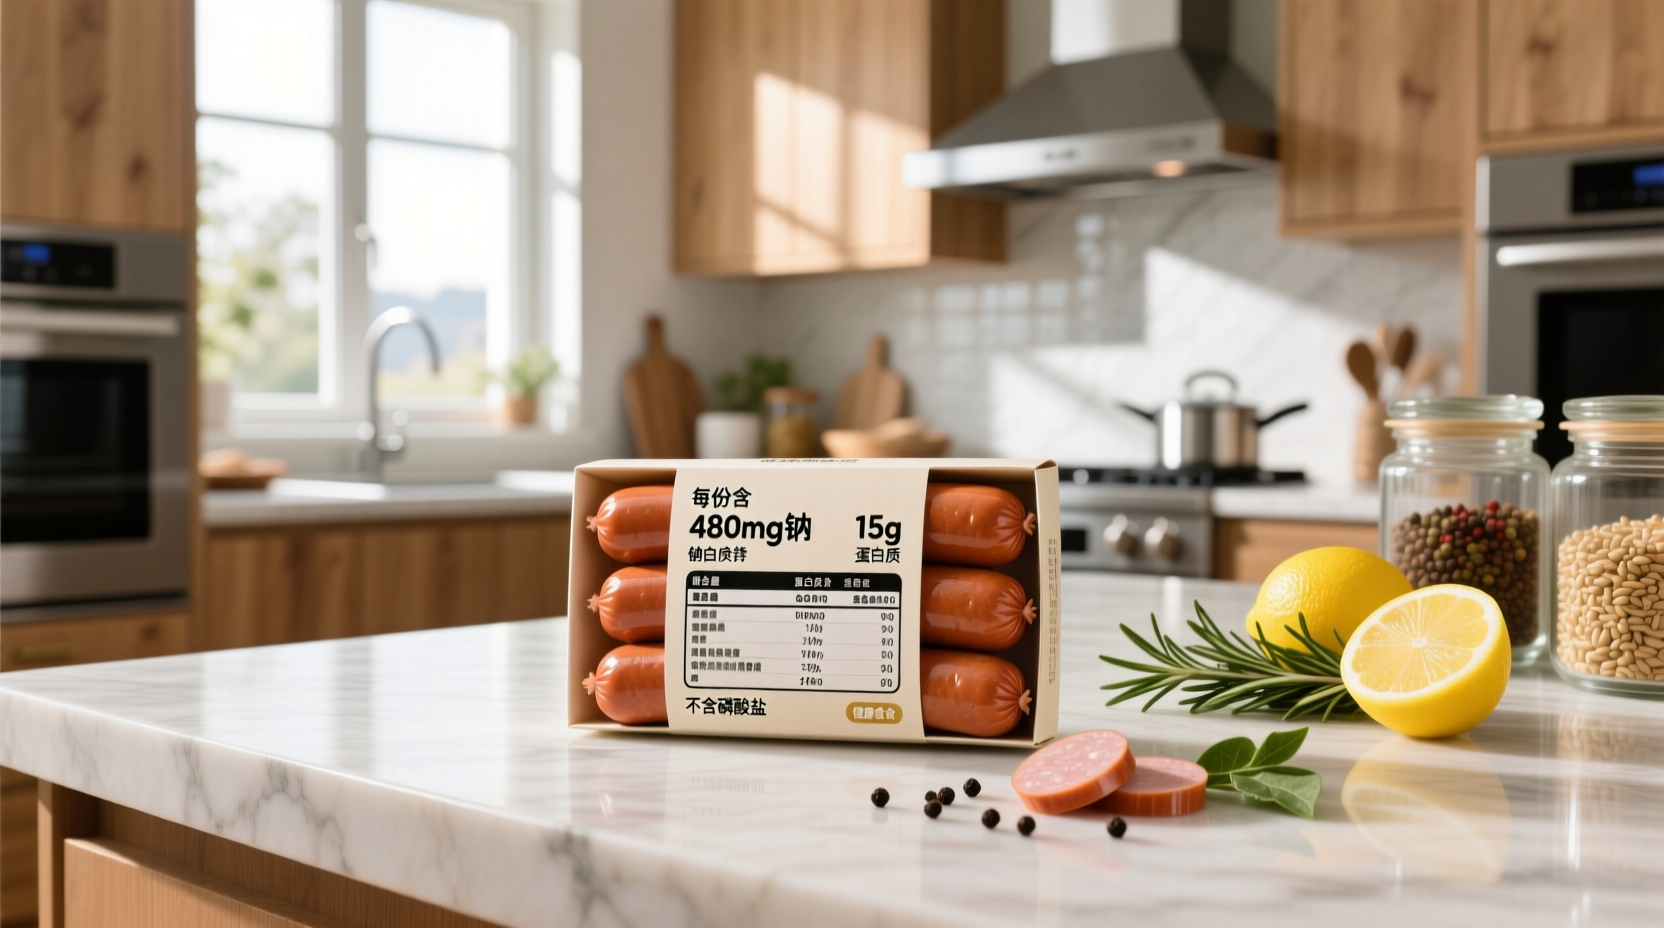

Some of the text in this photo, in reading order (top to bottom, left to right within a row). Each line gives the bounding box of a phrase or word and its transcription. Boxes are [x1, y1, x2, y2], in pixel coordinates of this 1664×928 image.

[692, 487, 752, 508] 每份含
[689, 512, 812, 547] 480mg钠
[855, 514, 902, 546] 15g
[855, 546, 901, 563] 蛋白质
[685, 697, 767, 716] 不含磷酸盐
